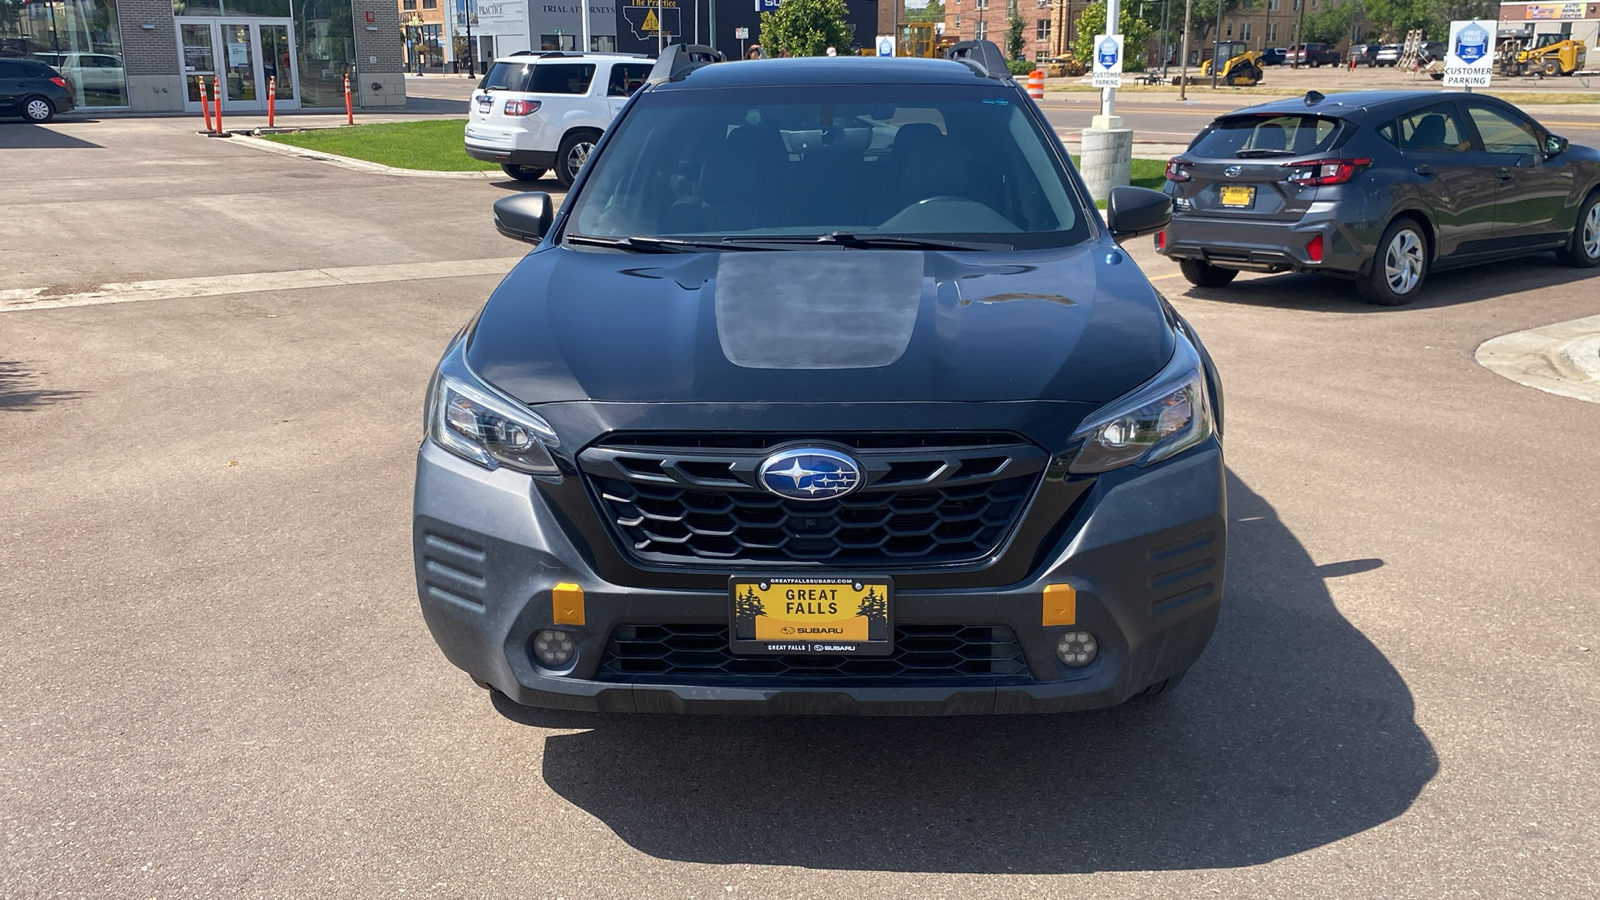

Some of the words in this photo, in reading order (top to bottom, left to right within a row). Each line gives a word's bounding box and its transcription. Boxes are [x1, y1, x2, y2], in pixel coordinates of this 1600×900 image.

[479, 5, 504, 16] PRACTICE
[542, 5, 568, 13] TRIAL
[1445, 67, 1492, 75] CUSTOMER
[1448, 77, 1486, 85] PARKING
[785, 589, 838, 601] GREAT
[786, 602, 838, 615] FALLS
